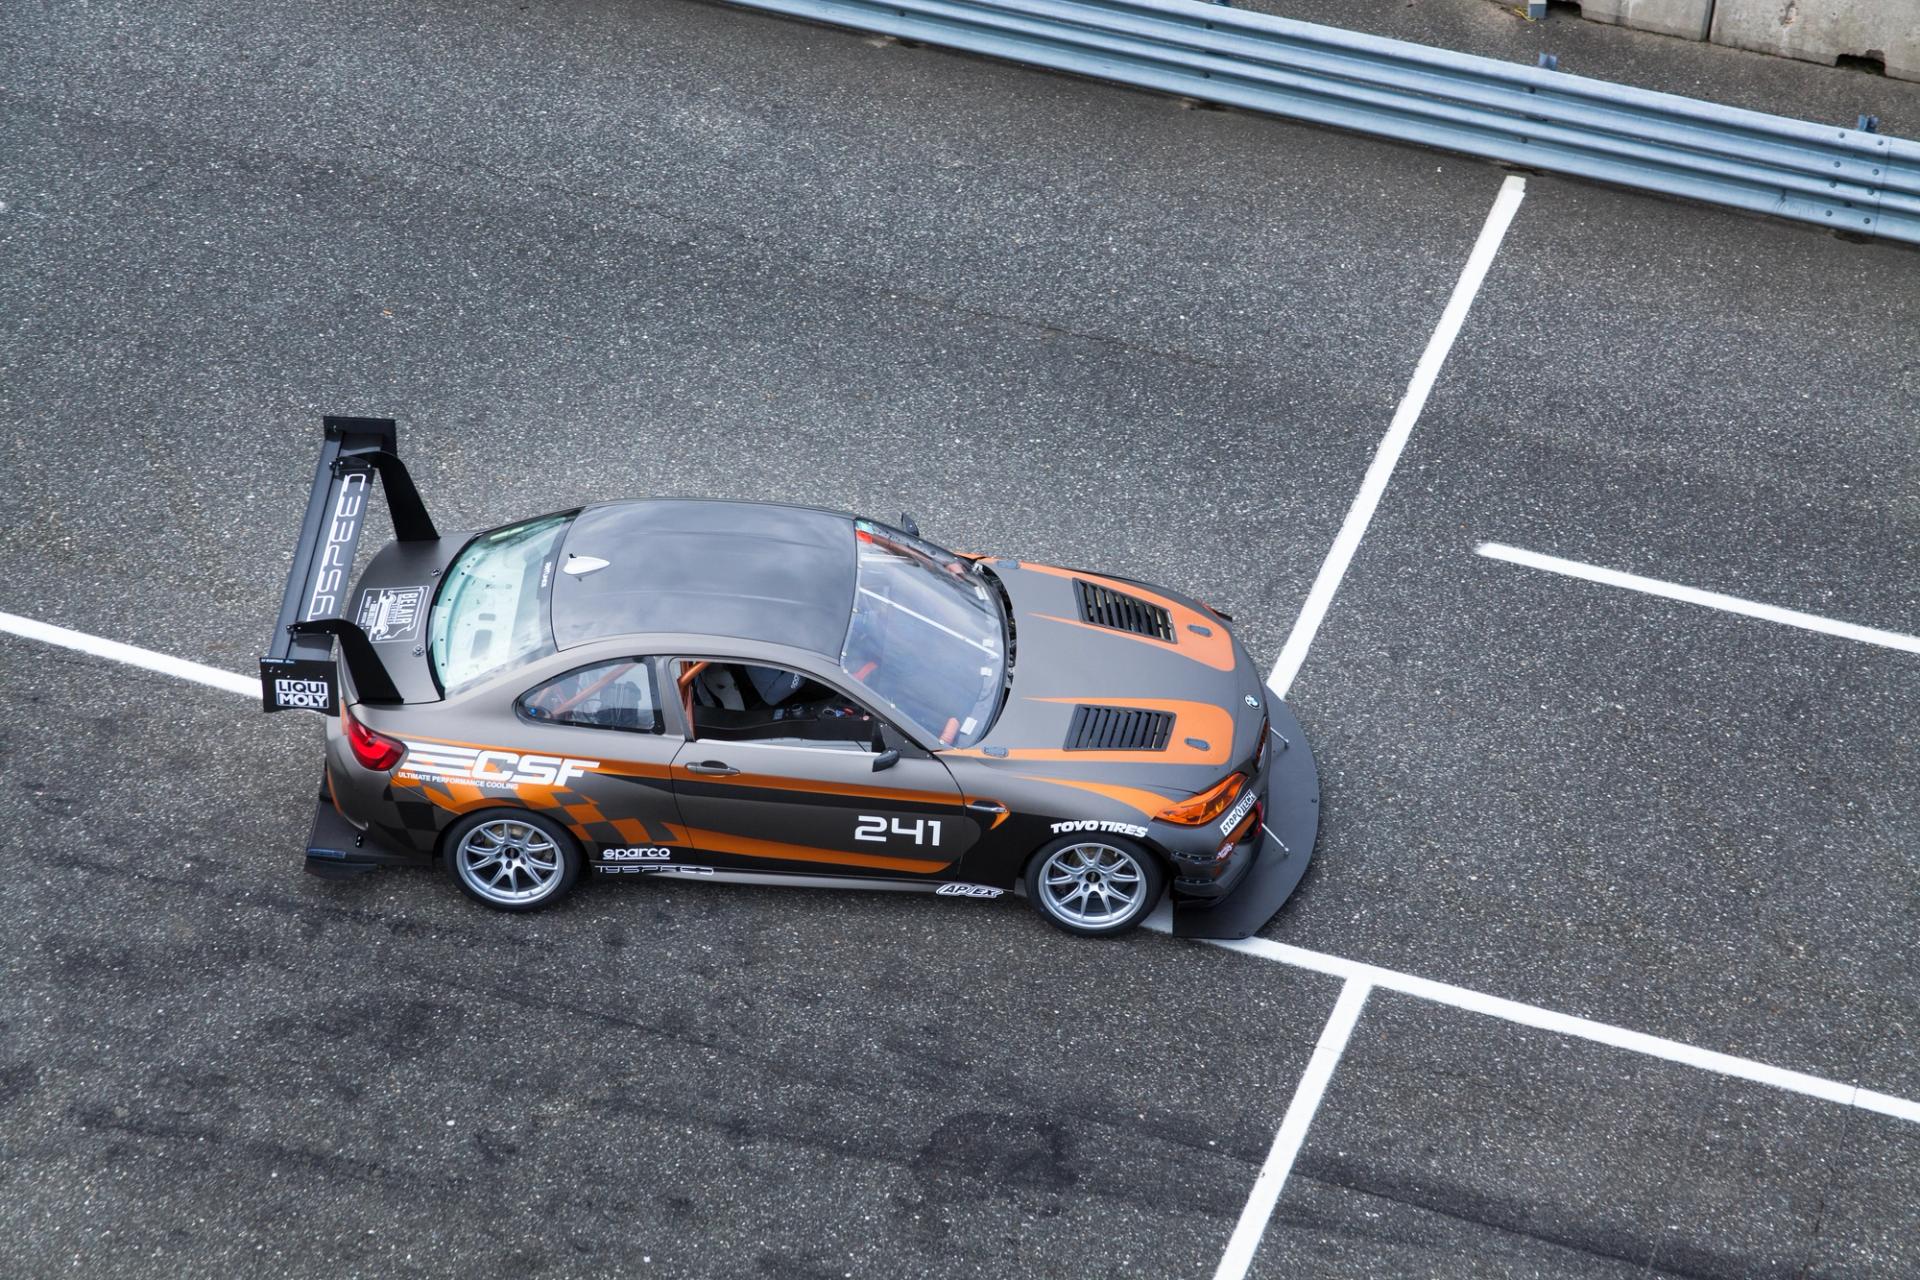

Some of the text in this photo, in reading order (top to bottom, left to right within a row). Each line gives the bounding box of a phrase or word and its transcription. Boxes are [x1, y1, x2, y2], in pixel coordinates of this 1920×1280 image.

[306, 473, 367, 622] YSPEED
[279, 681, 325, 694] LIQUI
[279, 693, 327, 707] MOLY
[398, 771, 519, 790] ULTIMATE PERFORMANCE COOLING
[854, 815, 942, 847] 241
[1050, 820, 1149, 838] TOYO TIRES
[602, 847, 671, 861] sparco
